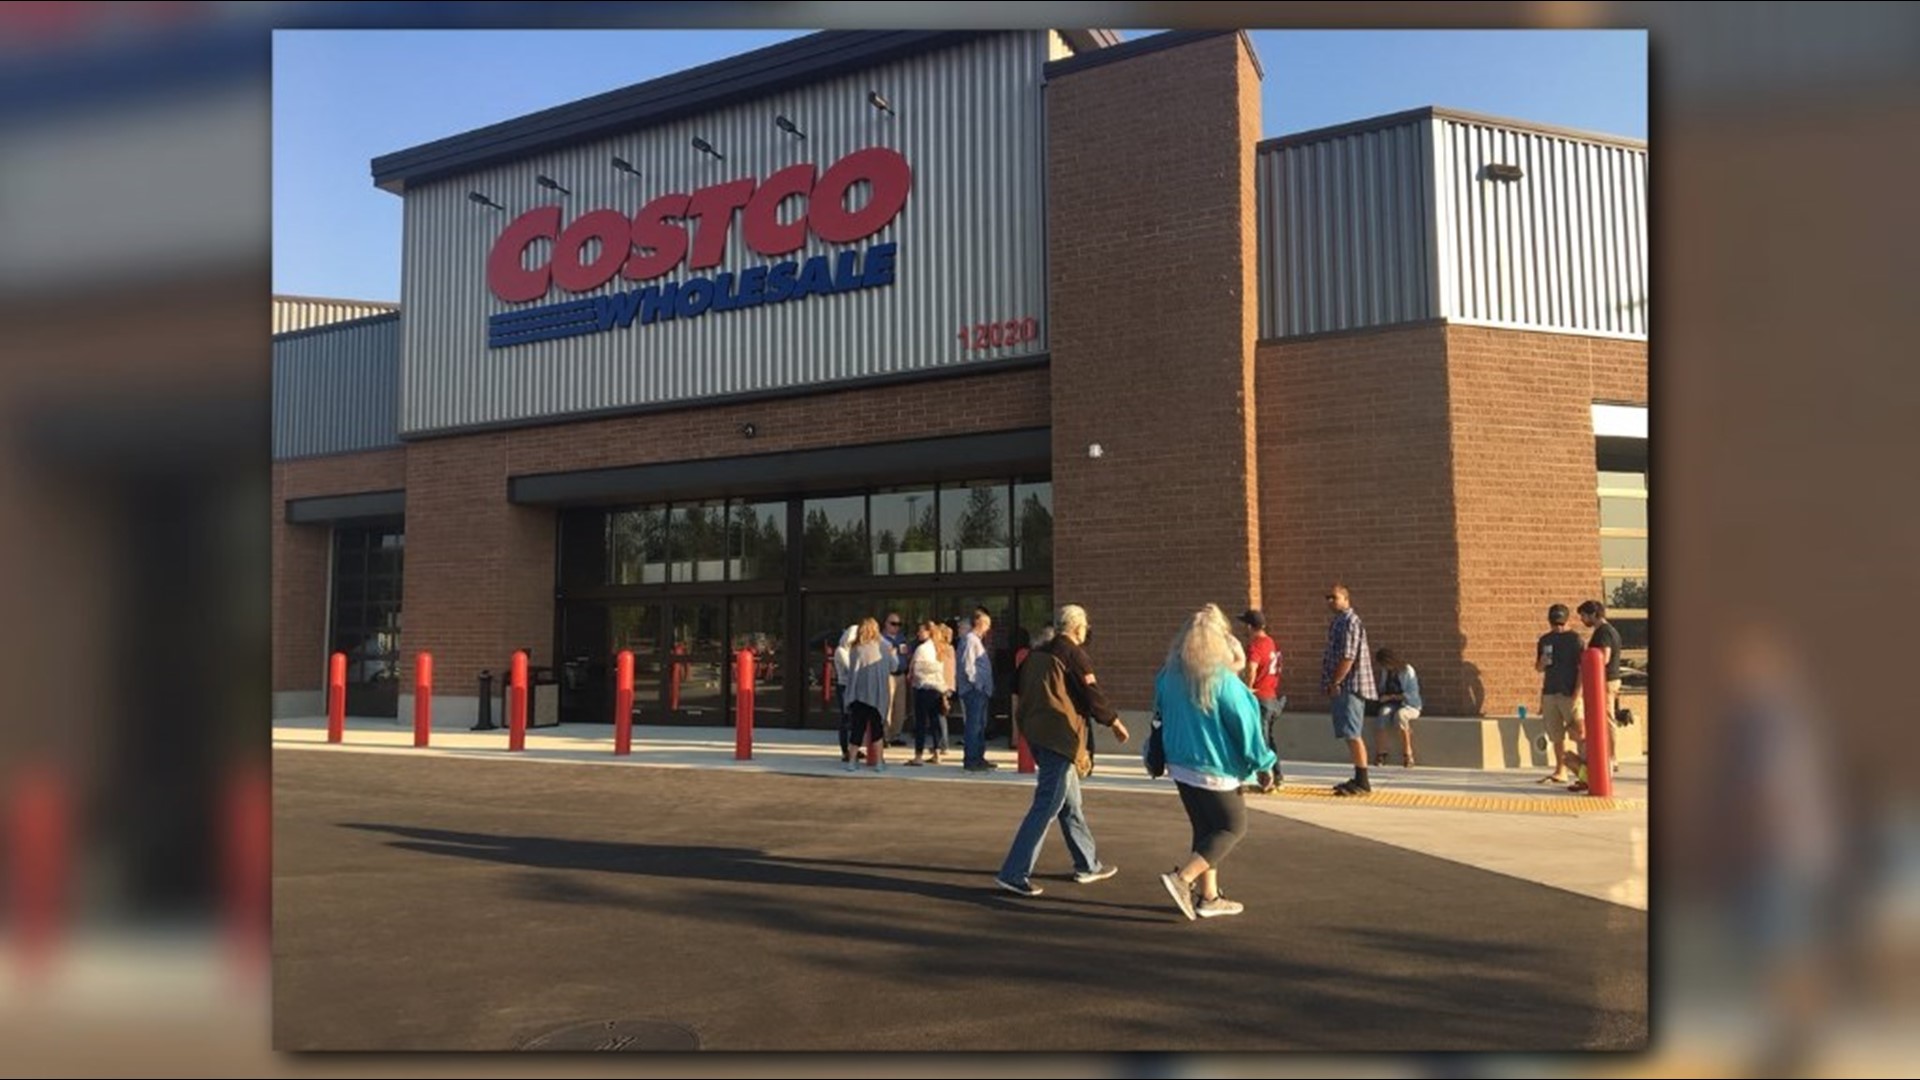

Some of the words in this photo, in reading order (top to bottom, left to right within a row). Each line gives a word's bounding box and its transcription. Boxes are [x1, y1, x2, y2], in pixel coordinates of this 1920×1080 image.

[487, 147, 912, 303] COSTCO
[598, 243, 896, 331] WHOLESALE
[958, 317, 1038, 350] 12020
